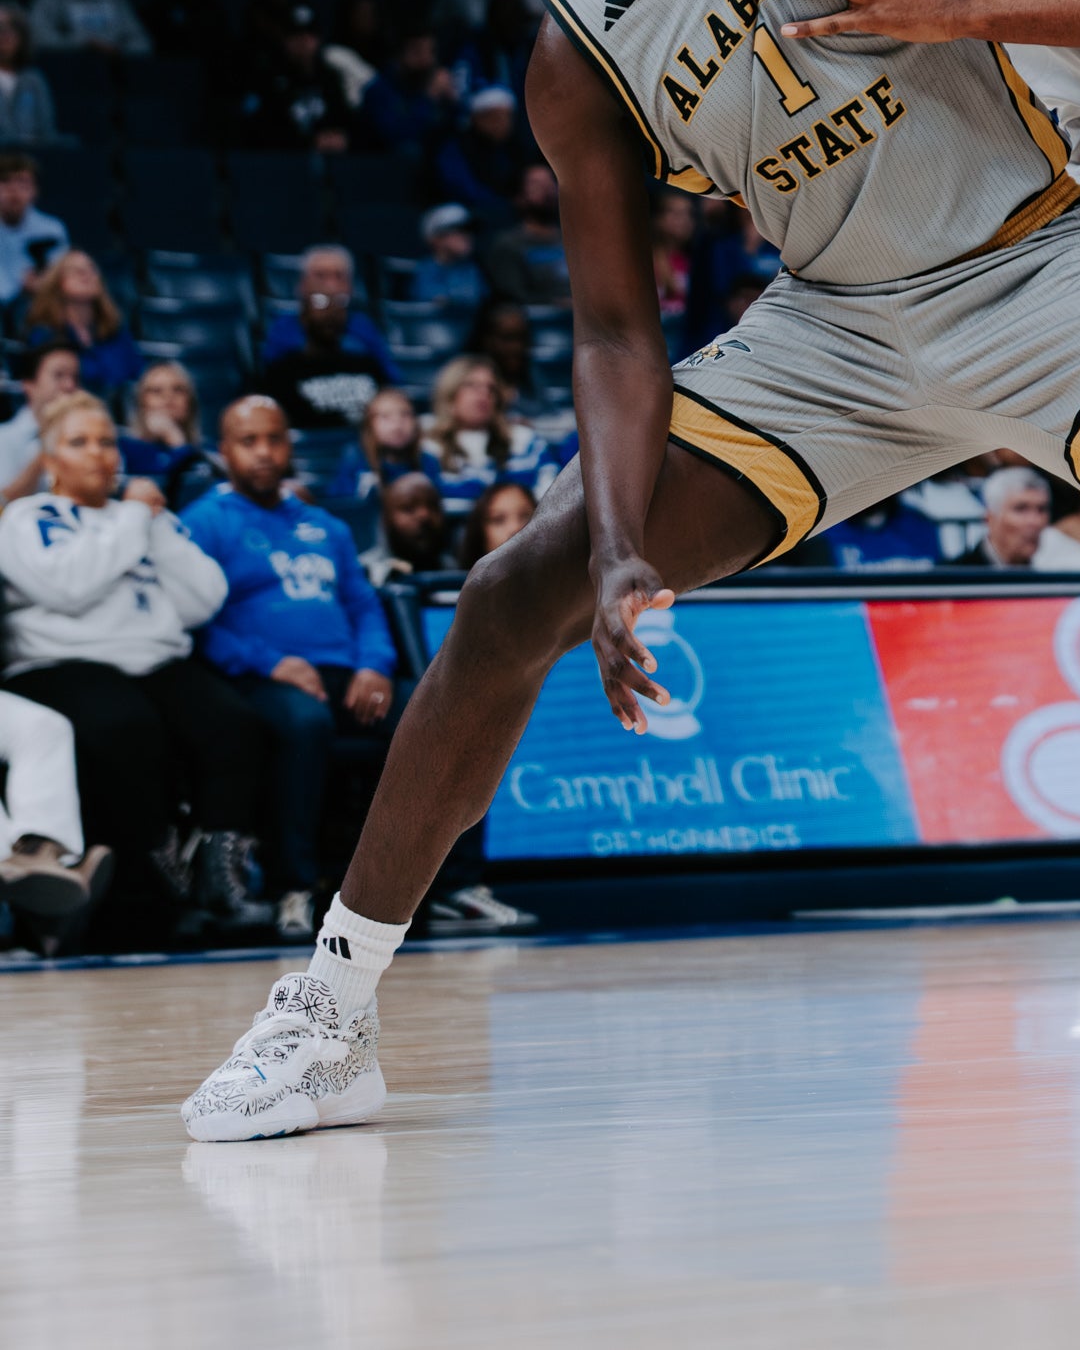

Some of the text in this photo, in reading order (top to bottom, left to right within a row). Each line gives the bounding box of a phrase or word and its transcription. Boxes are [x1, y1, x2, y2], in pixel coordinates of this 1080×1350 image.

[753, 24, 820, 118] 1
[753, 74, 907, 195] STATE
[510, 752, 855, 822] Campbell Clinic
